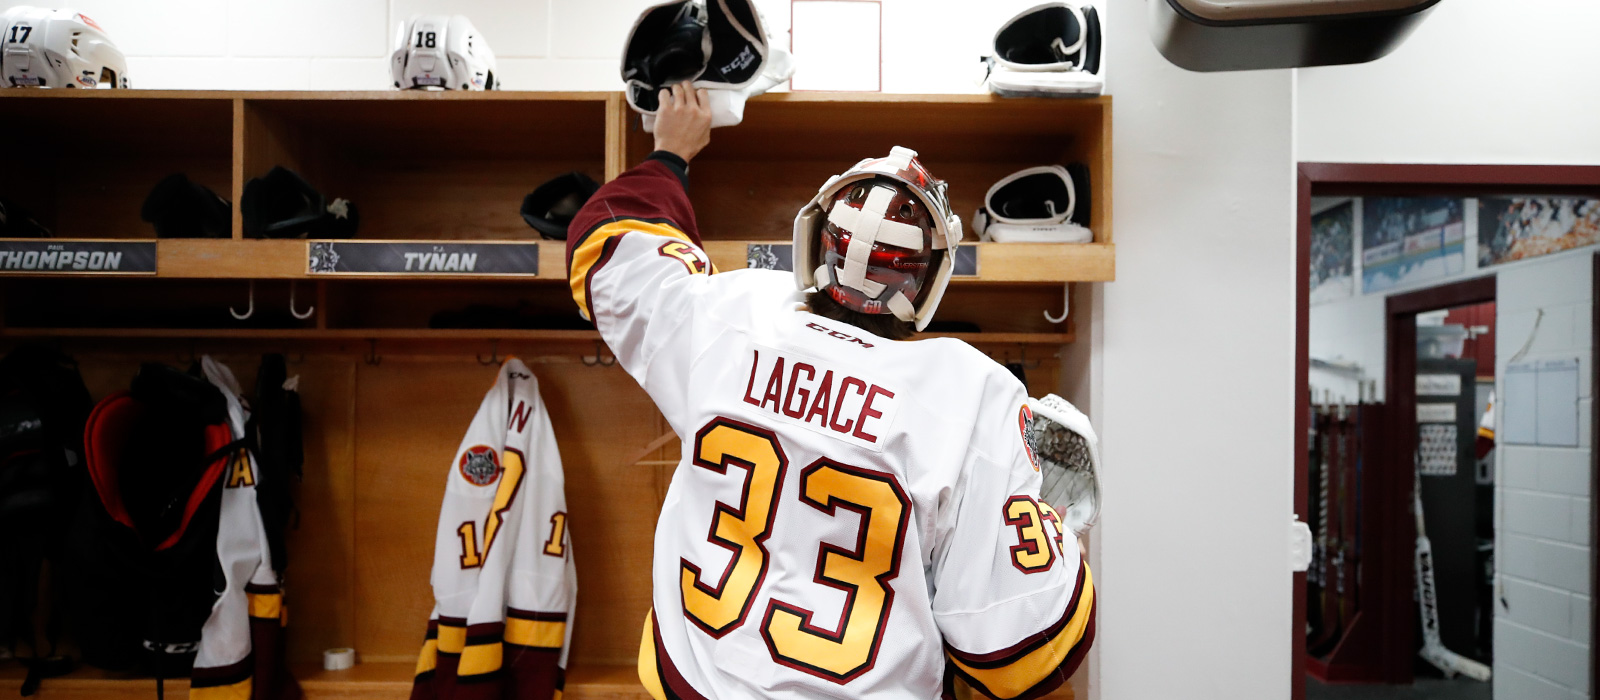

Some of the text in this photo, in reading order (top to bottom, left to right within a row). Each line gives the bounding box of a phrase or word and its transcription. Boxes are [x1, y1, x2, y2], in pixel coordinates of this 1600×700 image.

[9, 26, 32, 43] 17
[416, 31, 436, 48] 18
[720, 44, 751, 75] CCM
[0, 251, 122, 270] THOMPSON
[404, 253, 477, 271] TYNAN
[805, 322, 874, 348] CCM
[743, 350, 895, 443] LAGACE
[225, 448, 255, 488] A
[543, 511, 568, 558] 1
[680, 415, 912, 685] 33
